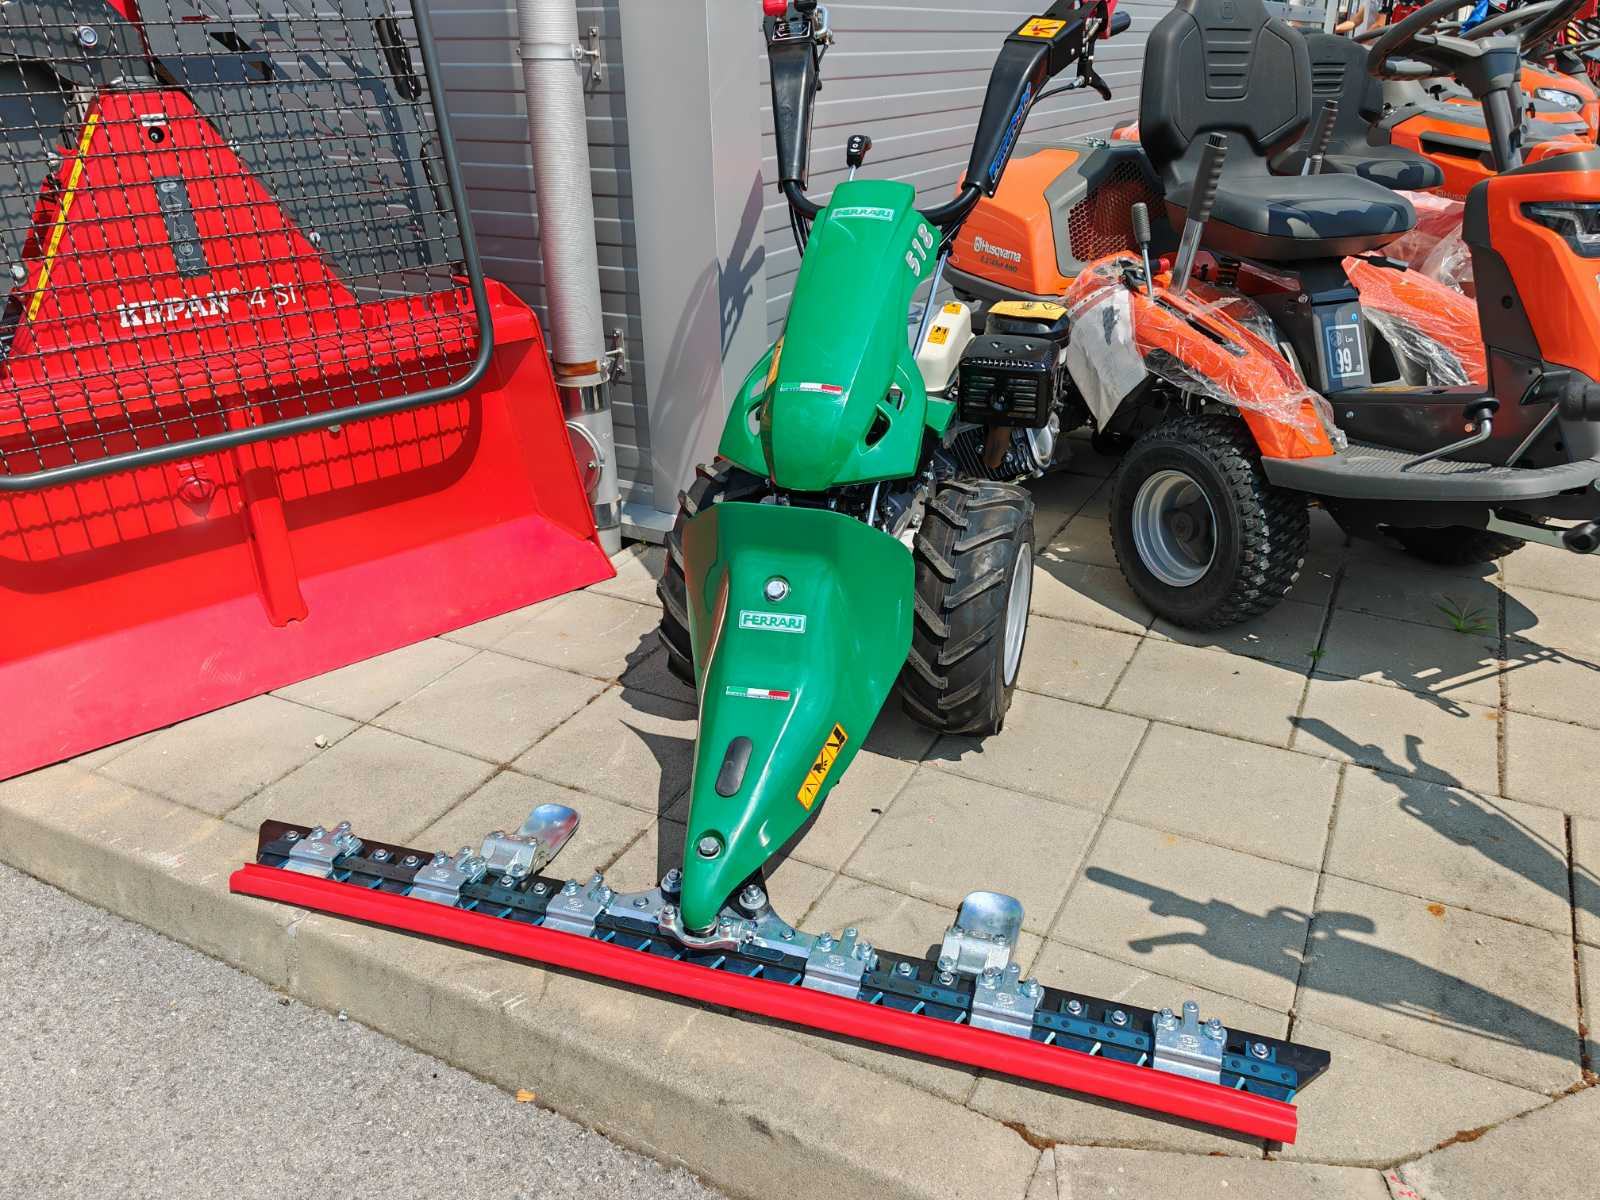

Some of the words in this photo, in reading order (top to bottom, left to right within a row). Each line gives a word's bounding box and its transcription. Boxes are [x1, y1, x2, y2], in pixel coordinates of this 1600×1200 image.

[834, 207, 892, 218] FERRARI
[905, 223, 934, 277] 518
[981, 239, 1021, 262] Husqvarna
[251, 286, 266, 308] 4
[1335, 347, 1352, 373] 99
[743, 613, 803, 629] FERRARI
